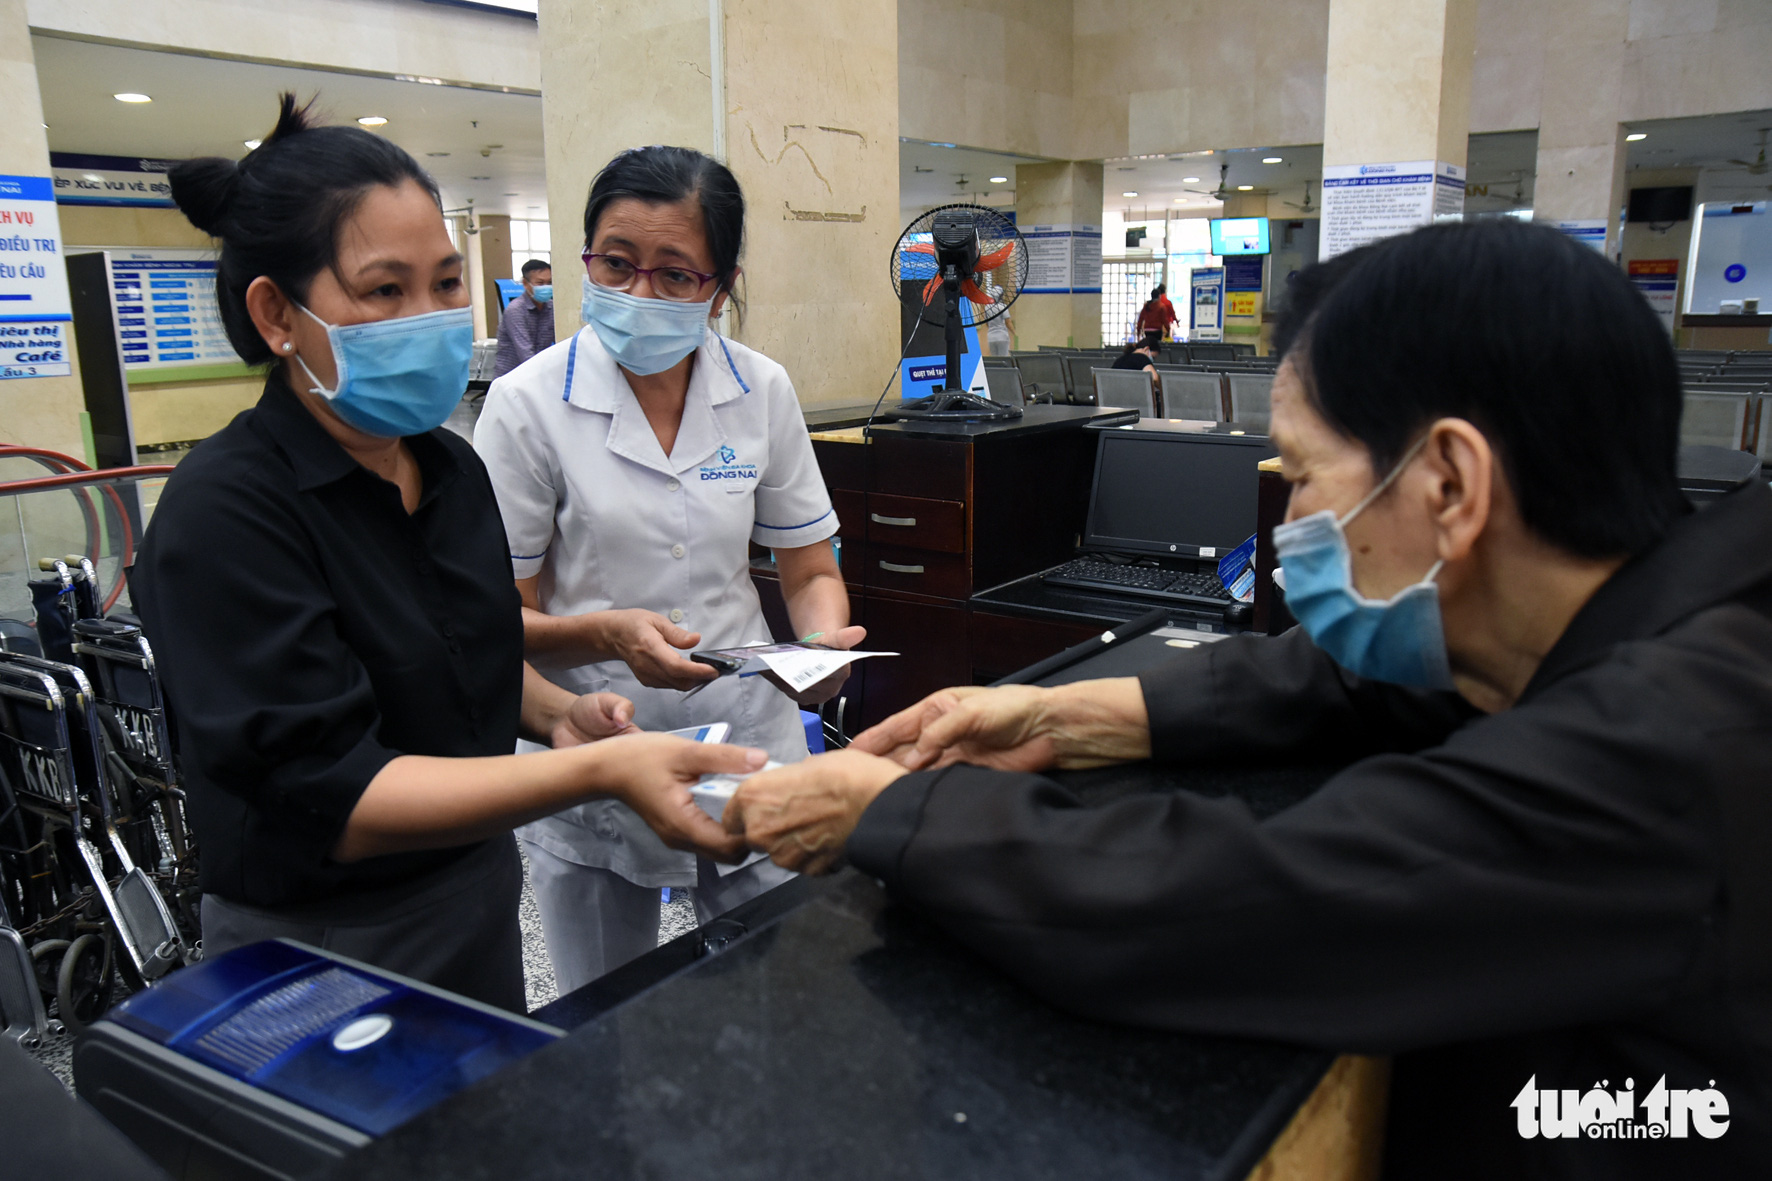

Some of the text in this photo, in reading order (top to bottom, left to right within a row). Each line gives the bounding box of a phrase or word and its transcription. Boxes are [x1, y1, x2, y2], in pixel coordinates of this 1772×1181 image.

[15, 211, 34, 227] VỤ
[33, 238, 56, 254] TRỊ
[33, 325, 59, 338] thị
[28, 339, 62, 349] hàng
[15, 350, 63, 363] Café
[27, 367, 38, 376] 3
[700, 470, 757, 480] ĐỒNG NAI
[115, 707, 158, 758] KKB
[18, 747, 62, 802] KKB
